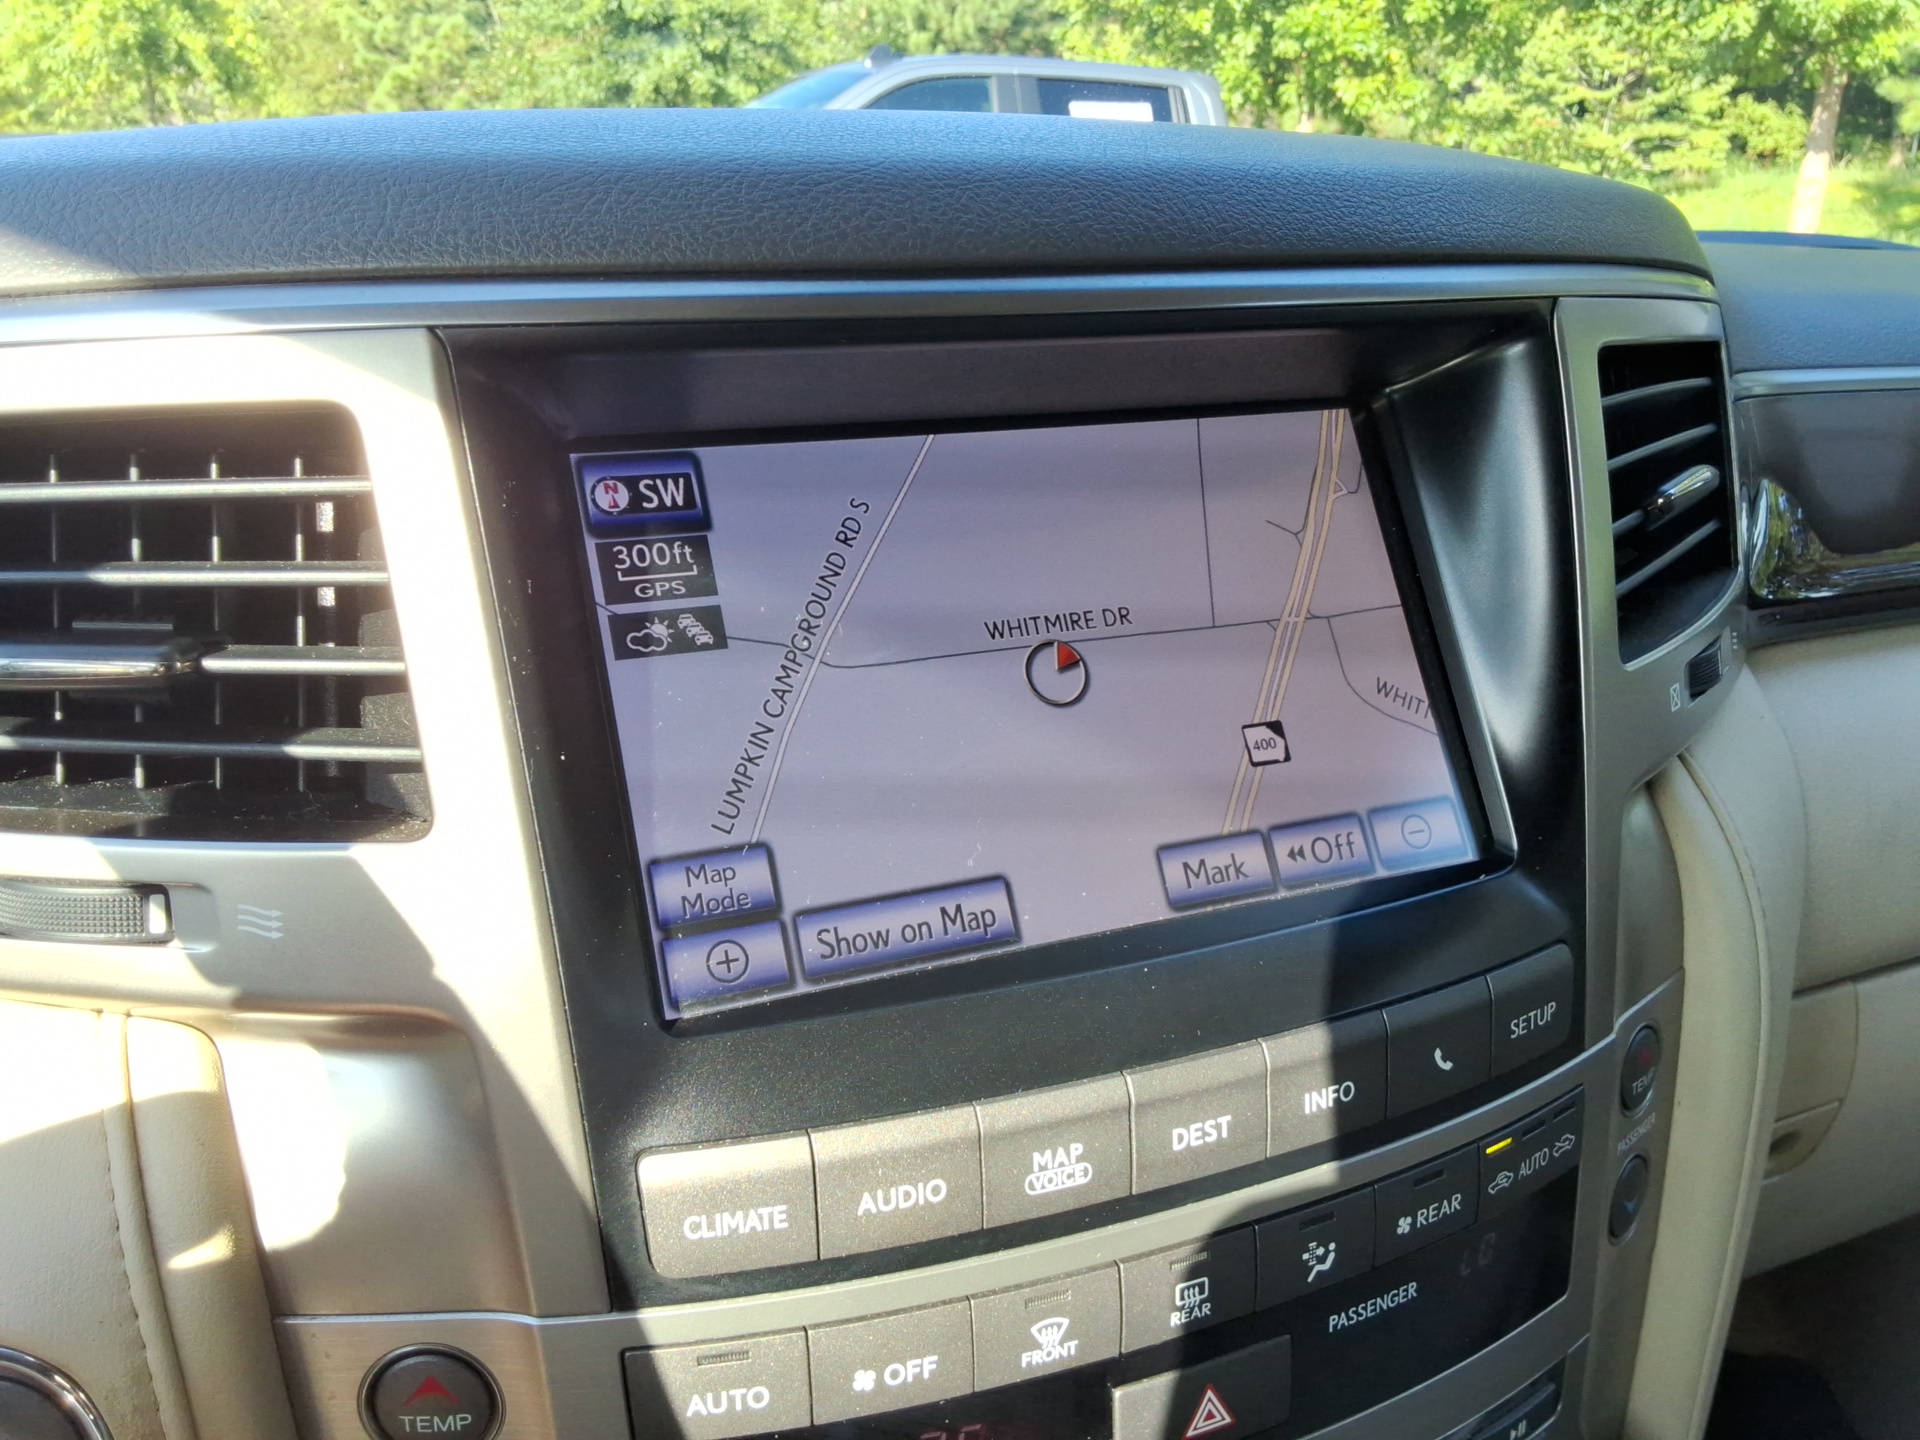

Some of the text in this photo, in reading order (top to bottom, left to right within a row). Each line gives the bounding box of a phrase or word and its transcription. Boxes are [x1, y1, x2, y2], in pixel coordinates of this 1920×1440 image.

[602, 481, 619, 495] N
[638, 477, 684, 509] SW
[612, 541, 695, 569] 300ft
[634, 580, 686, 598] GPS
[984, 606, 1133, 641] WHITMIRE DR
[710, 497, 871, 835] LUMPKIN CAMPGROUND RD S
[1252, 737, 1277, 752] 400
[1310, 831, 1357, 865] Off
[684, 863, 737, 887] Map
[1182, 853, 1250, 890] Mark
[681, 888, 750, 919] Mode
[816, 902, 997, 960] Show on Map
[1510, 1001, 1557, 1040] SETUP
[1303, 1080, 1356, 1115] INFO
[1171, 1115, 1232, 1152] DEST
[1032, 1143, 1084, 1171] MAP
[1518, 1147, 1550, 1182] AUTO
[1033, 1164, 1086, 1191] VOICE
[857, 1178, 948, 1216] AUDIO
[1416, 1193, 1463, 1229] REAR
[682, 1205, 789, 1240] CLIMATE
[1170, 1303, 1212, 1328] REAR
[1327, 1281, 1419, 1334] PASSENGER
[1021, 1339, 1079, 1368] FRONT
[883, 1355, 939, 1386] OFF
[686, 1386, 770, 1418] AUTO
[398, 1413, 473, 1432] TEMP
